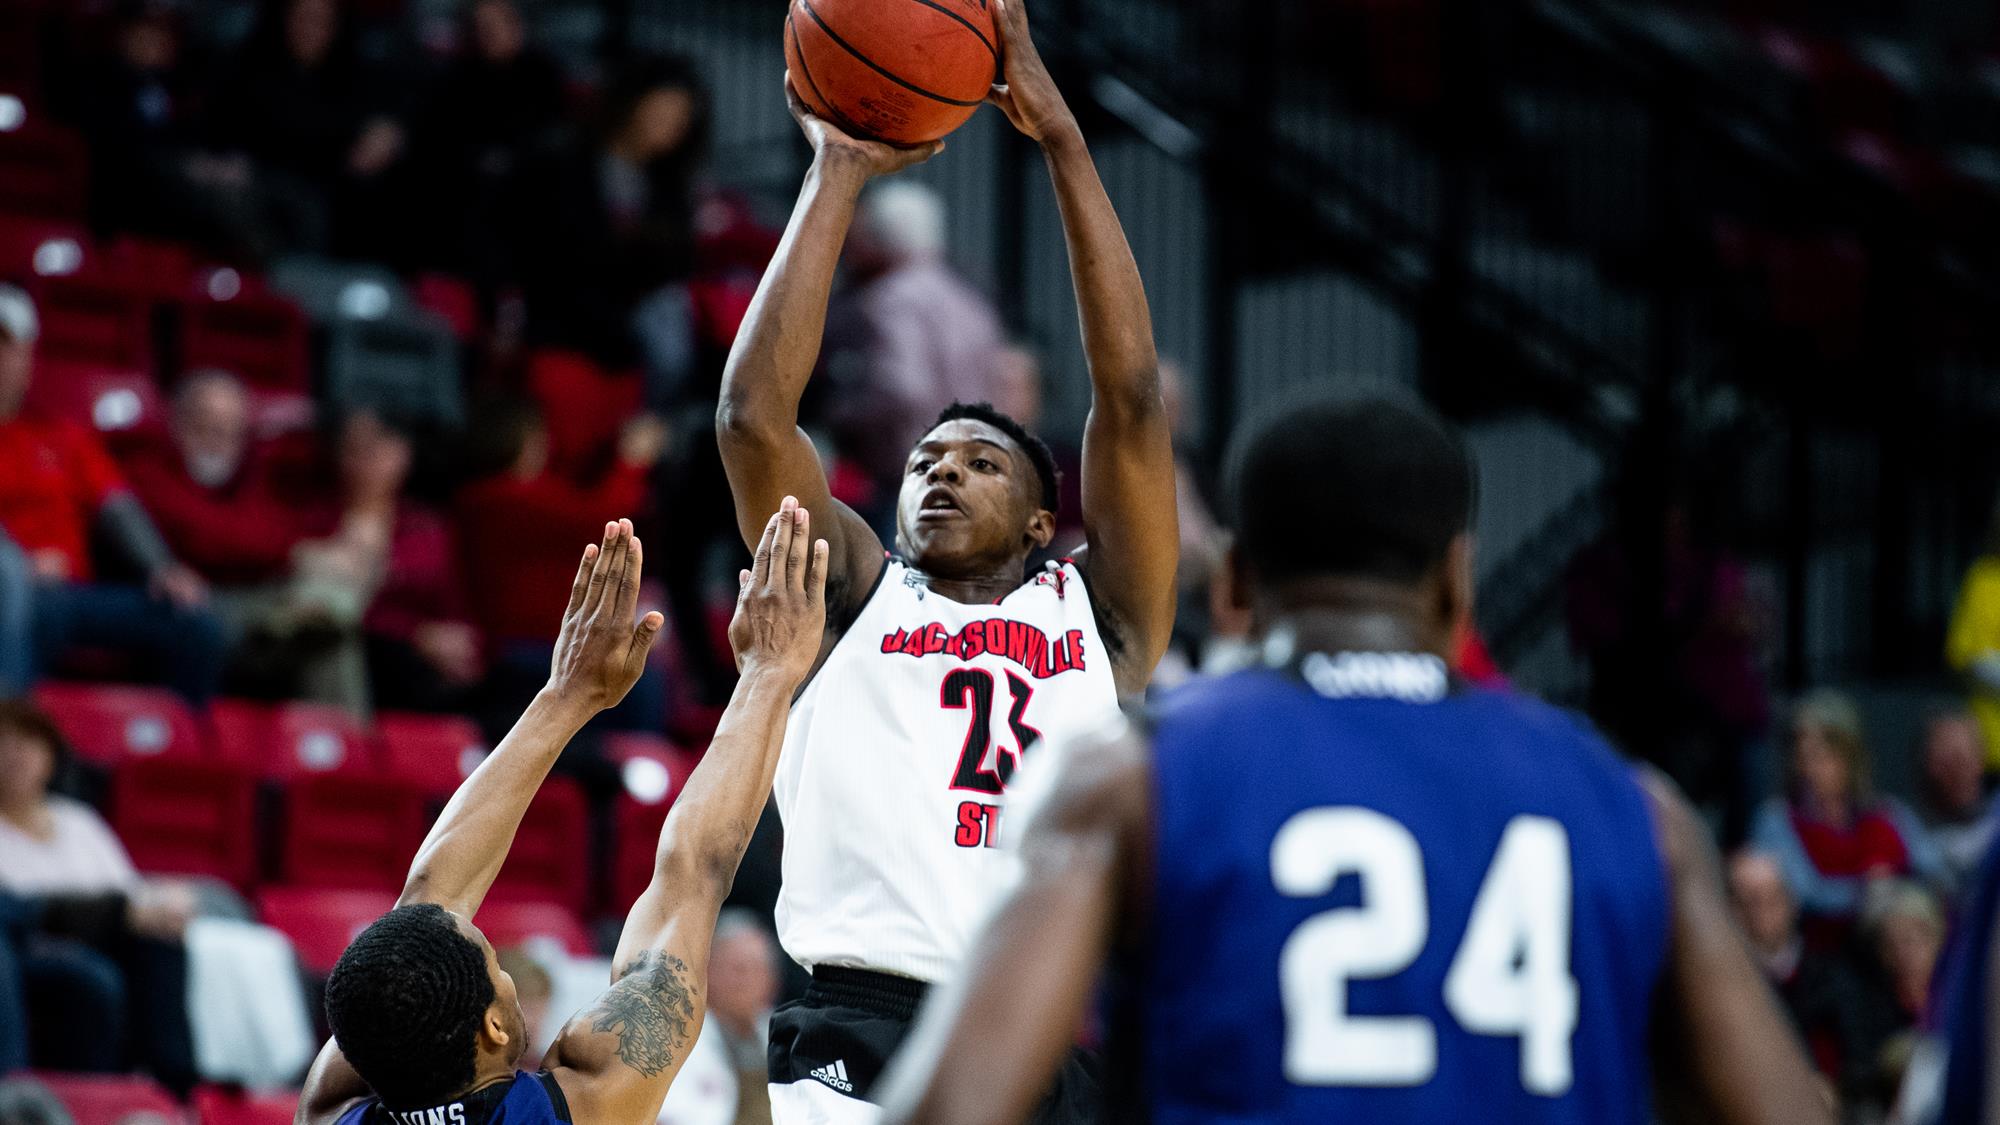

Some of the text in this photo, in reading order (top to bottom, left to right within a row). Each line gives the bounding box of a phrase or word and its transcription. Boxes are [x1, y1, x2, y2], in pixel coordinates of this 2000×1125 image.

[881, 618, 1086, 679] JACKSONVILLE
[941, 667, 1043, 795] 23
[1270, 805, 1580, 1096] 24
[810, 1069, 853, 1092] adidas
